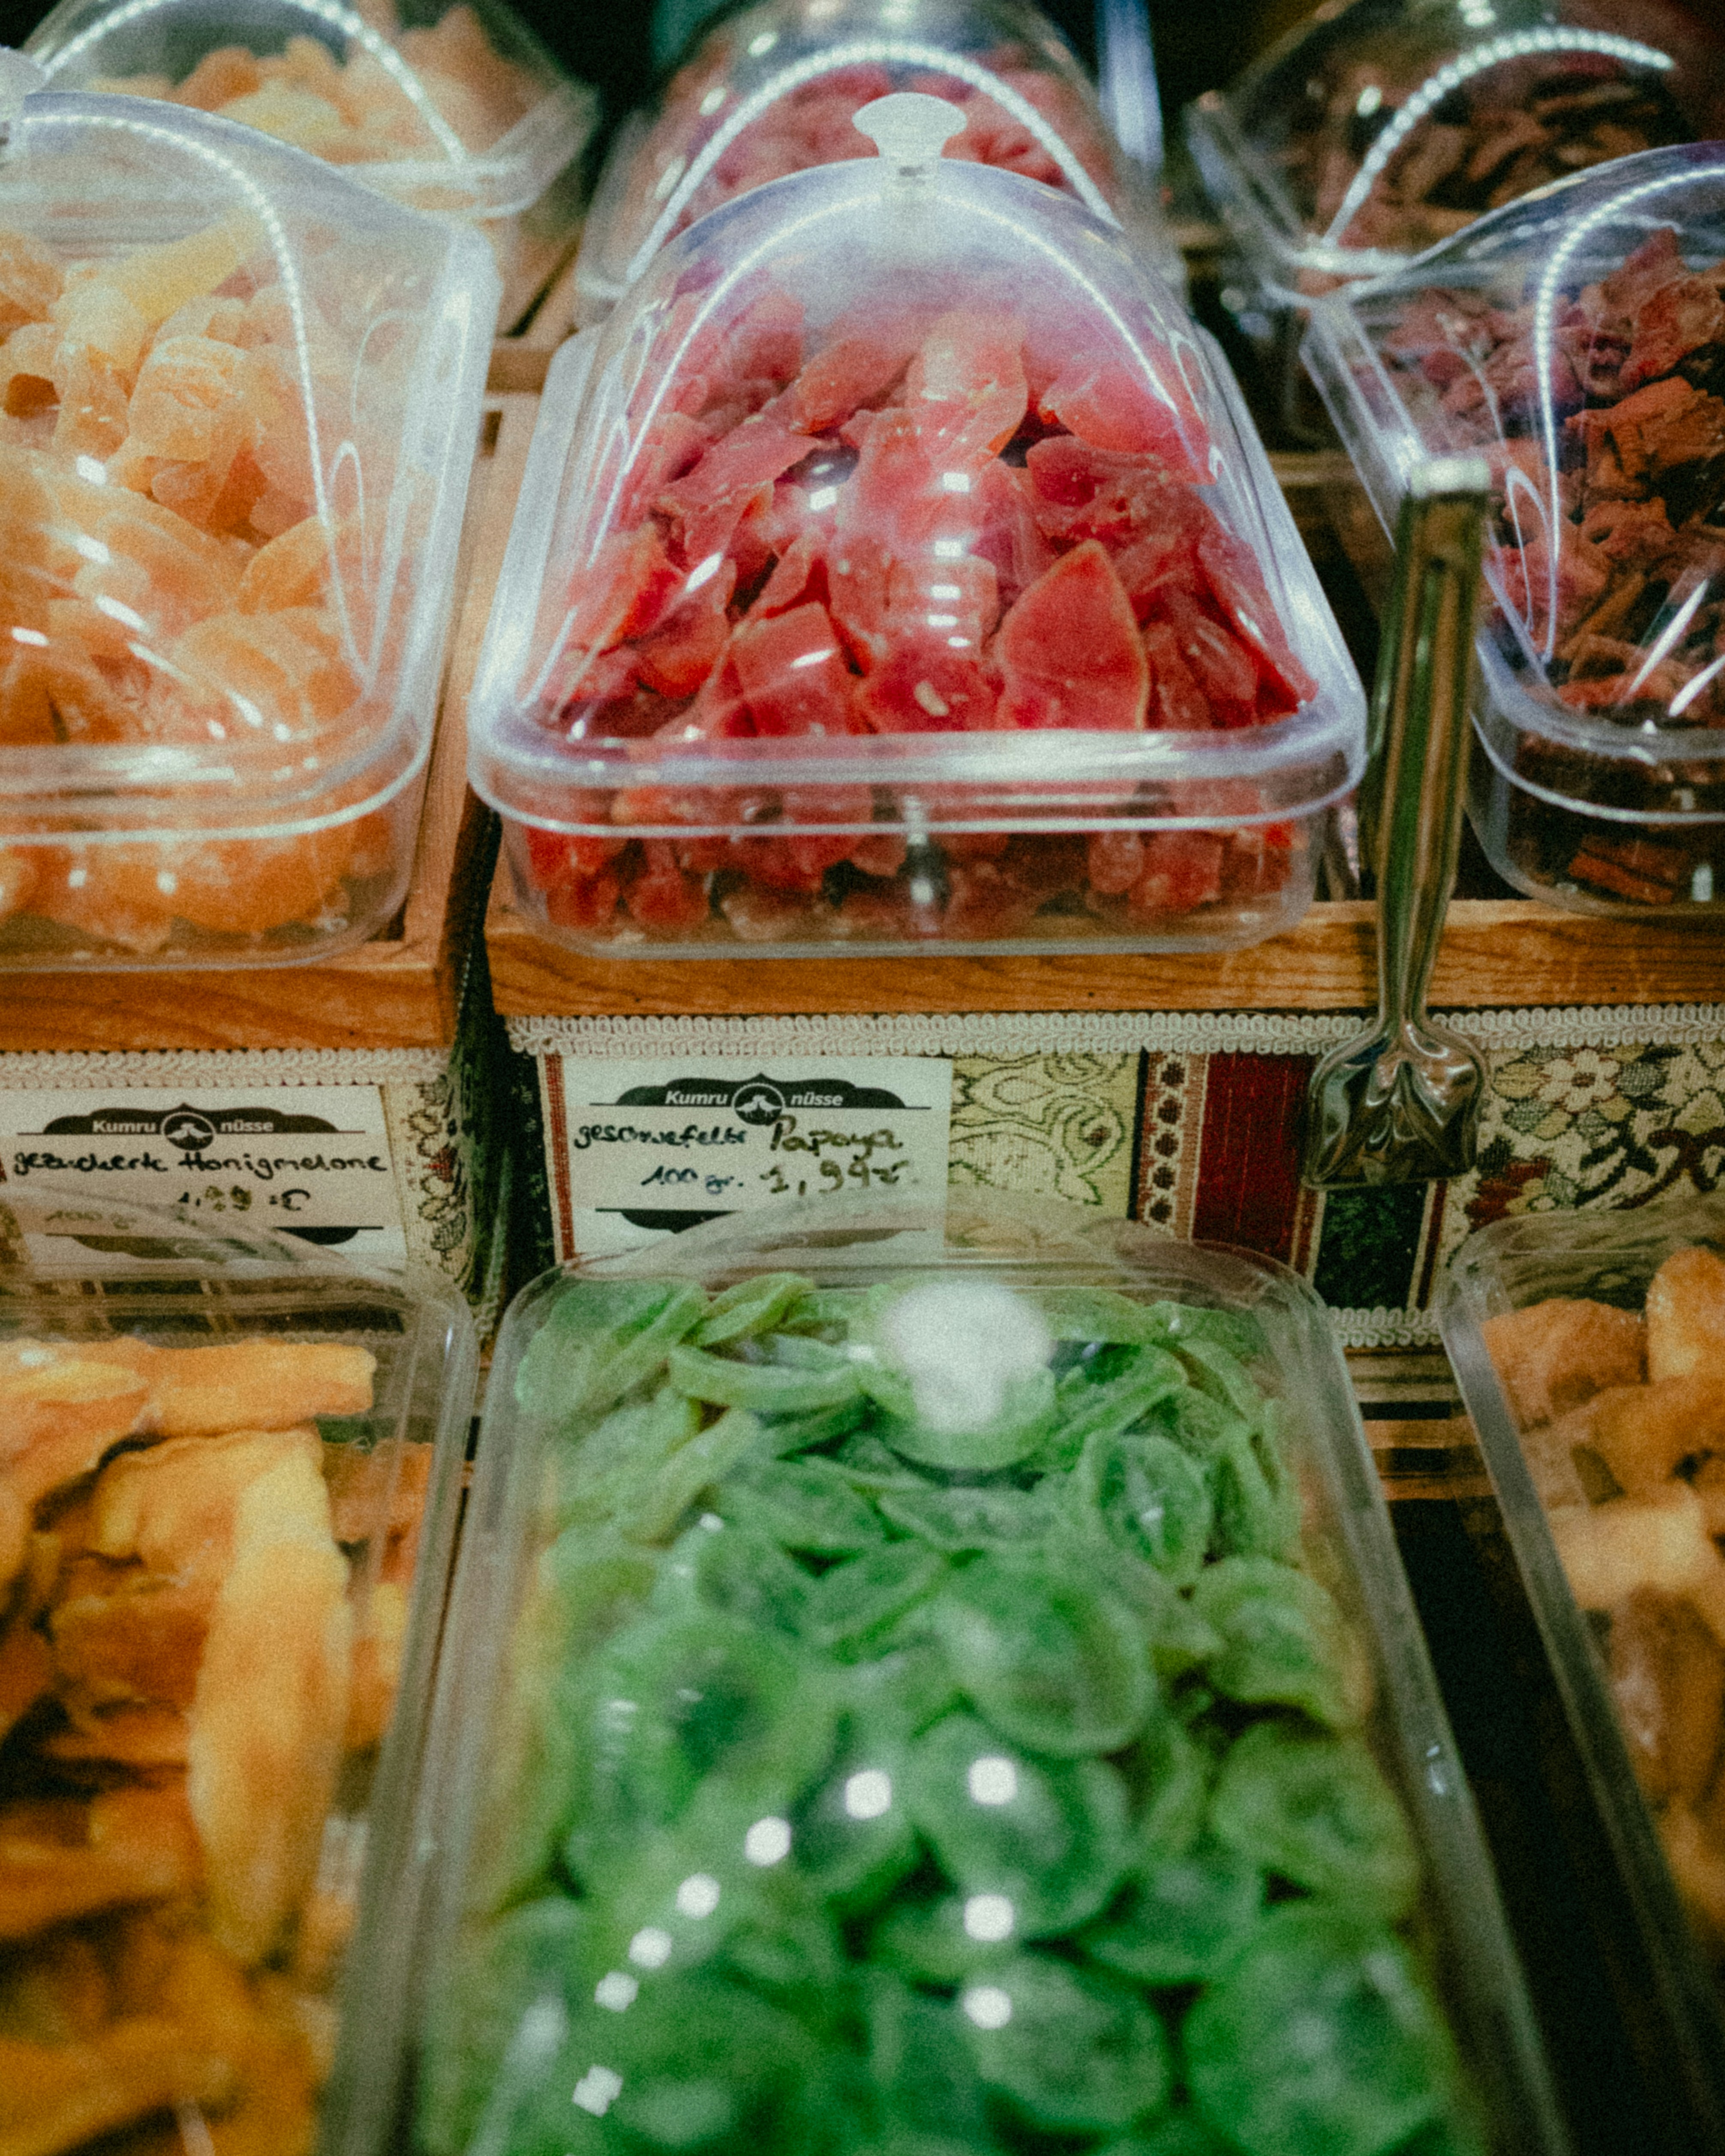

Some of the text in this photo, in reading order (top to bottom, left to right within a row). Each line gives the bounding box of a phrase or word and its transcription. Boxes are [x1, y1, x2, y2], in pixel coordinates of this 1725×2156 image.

[665, 1090, 844, 1106] Kumru nüsse
[92, 1120, 273, 1133] Kumru nüsse
[770, 1114, 903, 1160] Papaya
[178, 1152, 387, 1180] Honigmelone
[641, 1166, 698, 1185] 100
